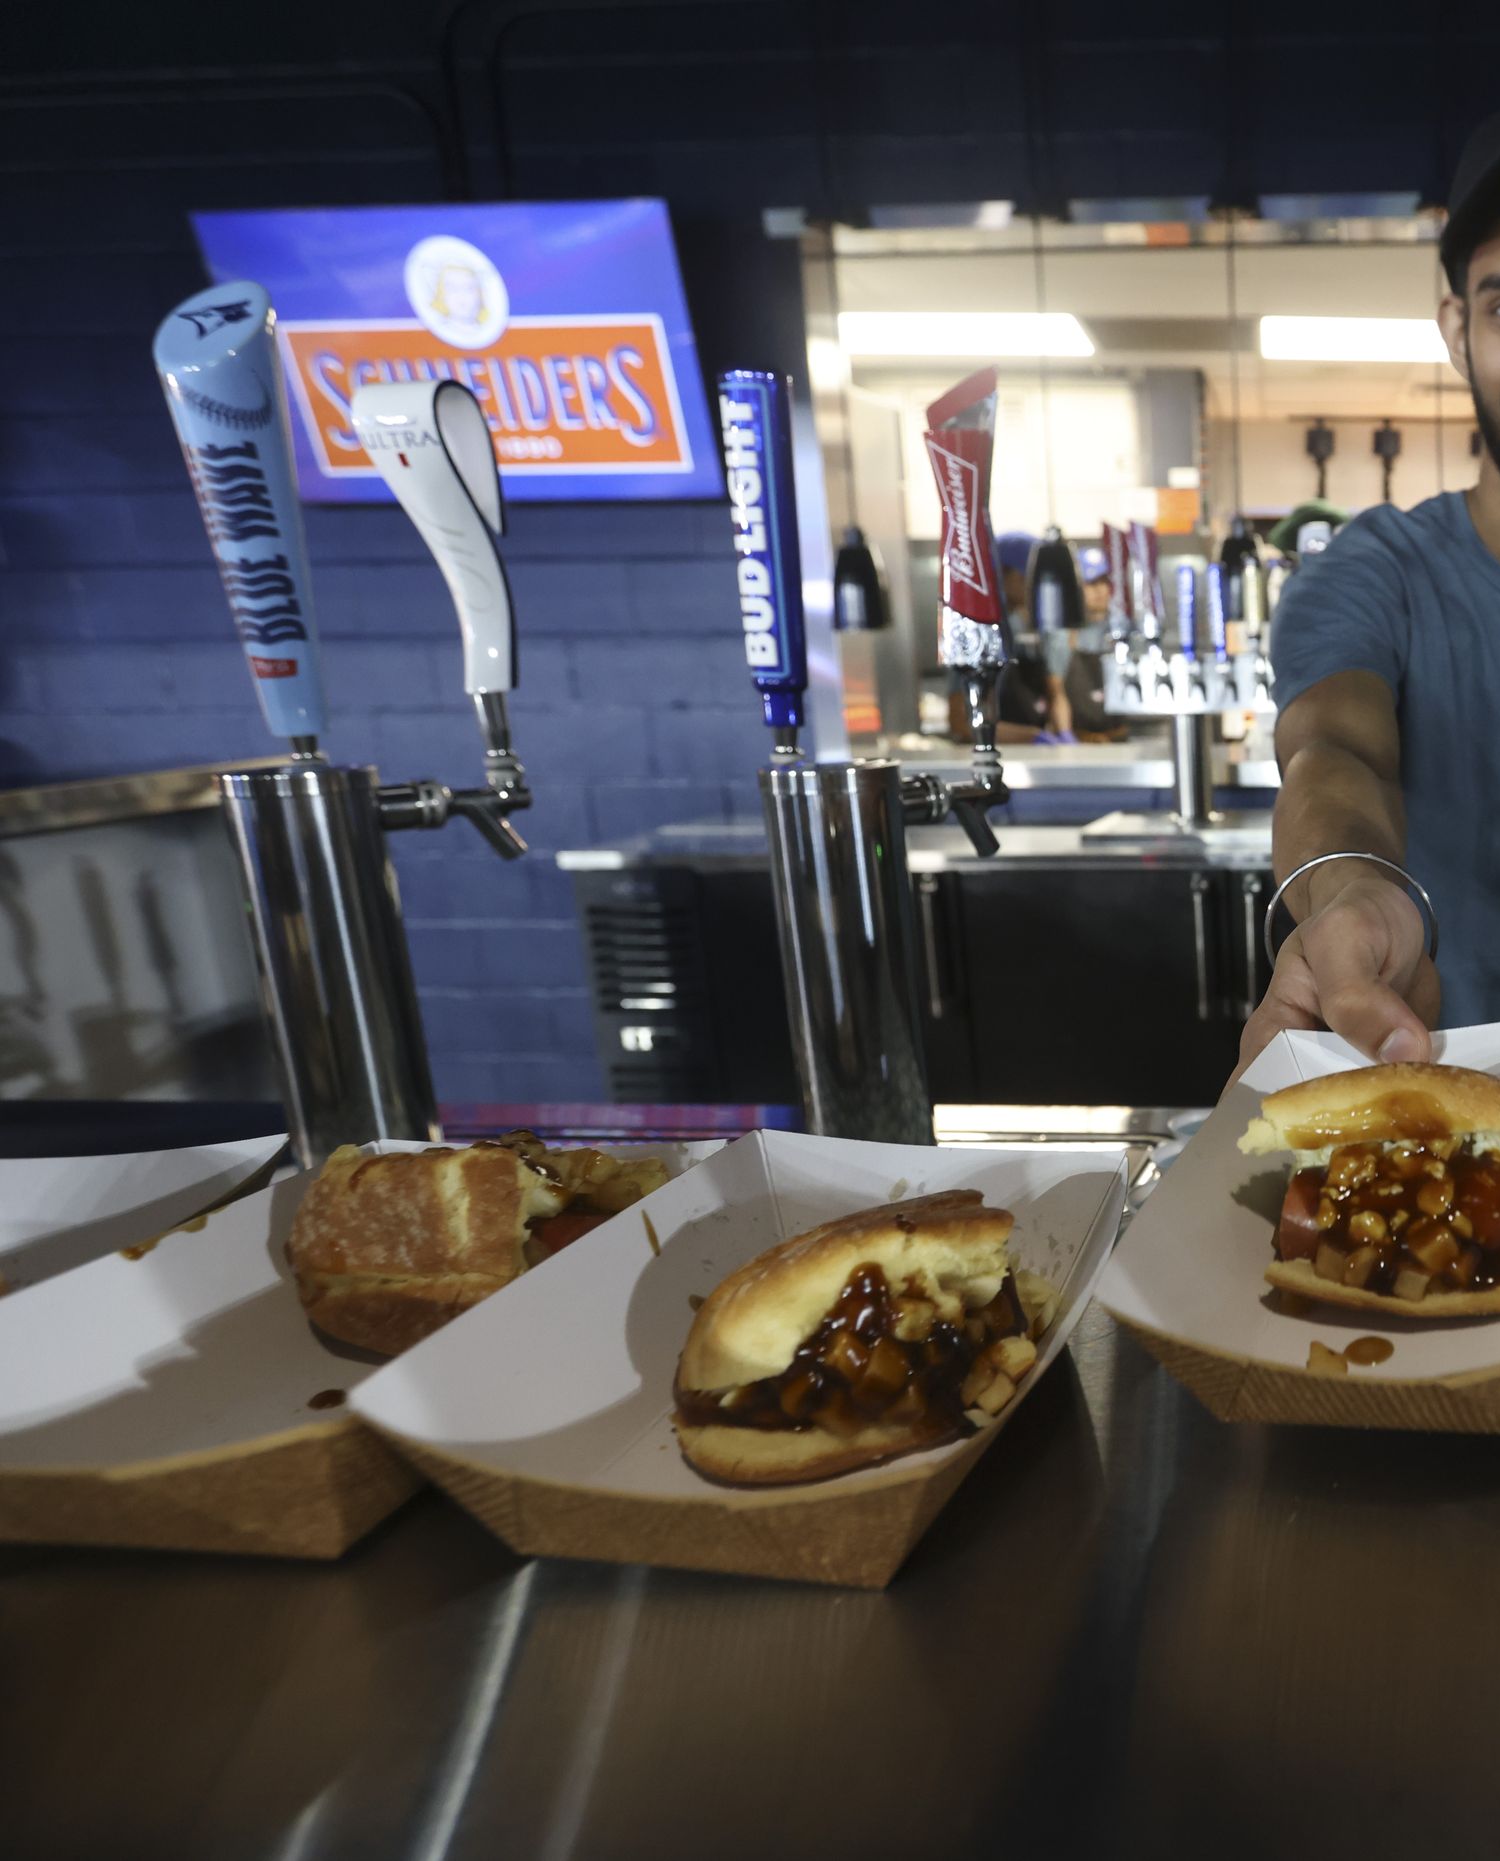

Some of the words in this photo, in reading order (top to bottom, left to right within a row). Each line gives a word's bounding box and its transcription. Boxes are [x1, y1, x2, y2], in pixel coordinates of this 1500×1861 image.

[309, 343, 664, 448] SEIDERS
[361, 431, 440, 450] ULTRA
[188, 440, 281, 541] WAVE
[719, 394, 766, 552] LIGHT
[945, 456, 974, 582] Budweiser
[220, 554, 308, 645] BLUE
[741, 558, 778, 667] BUD
